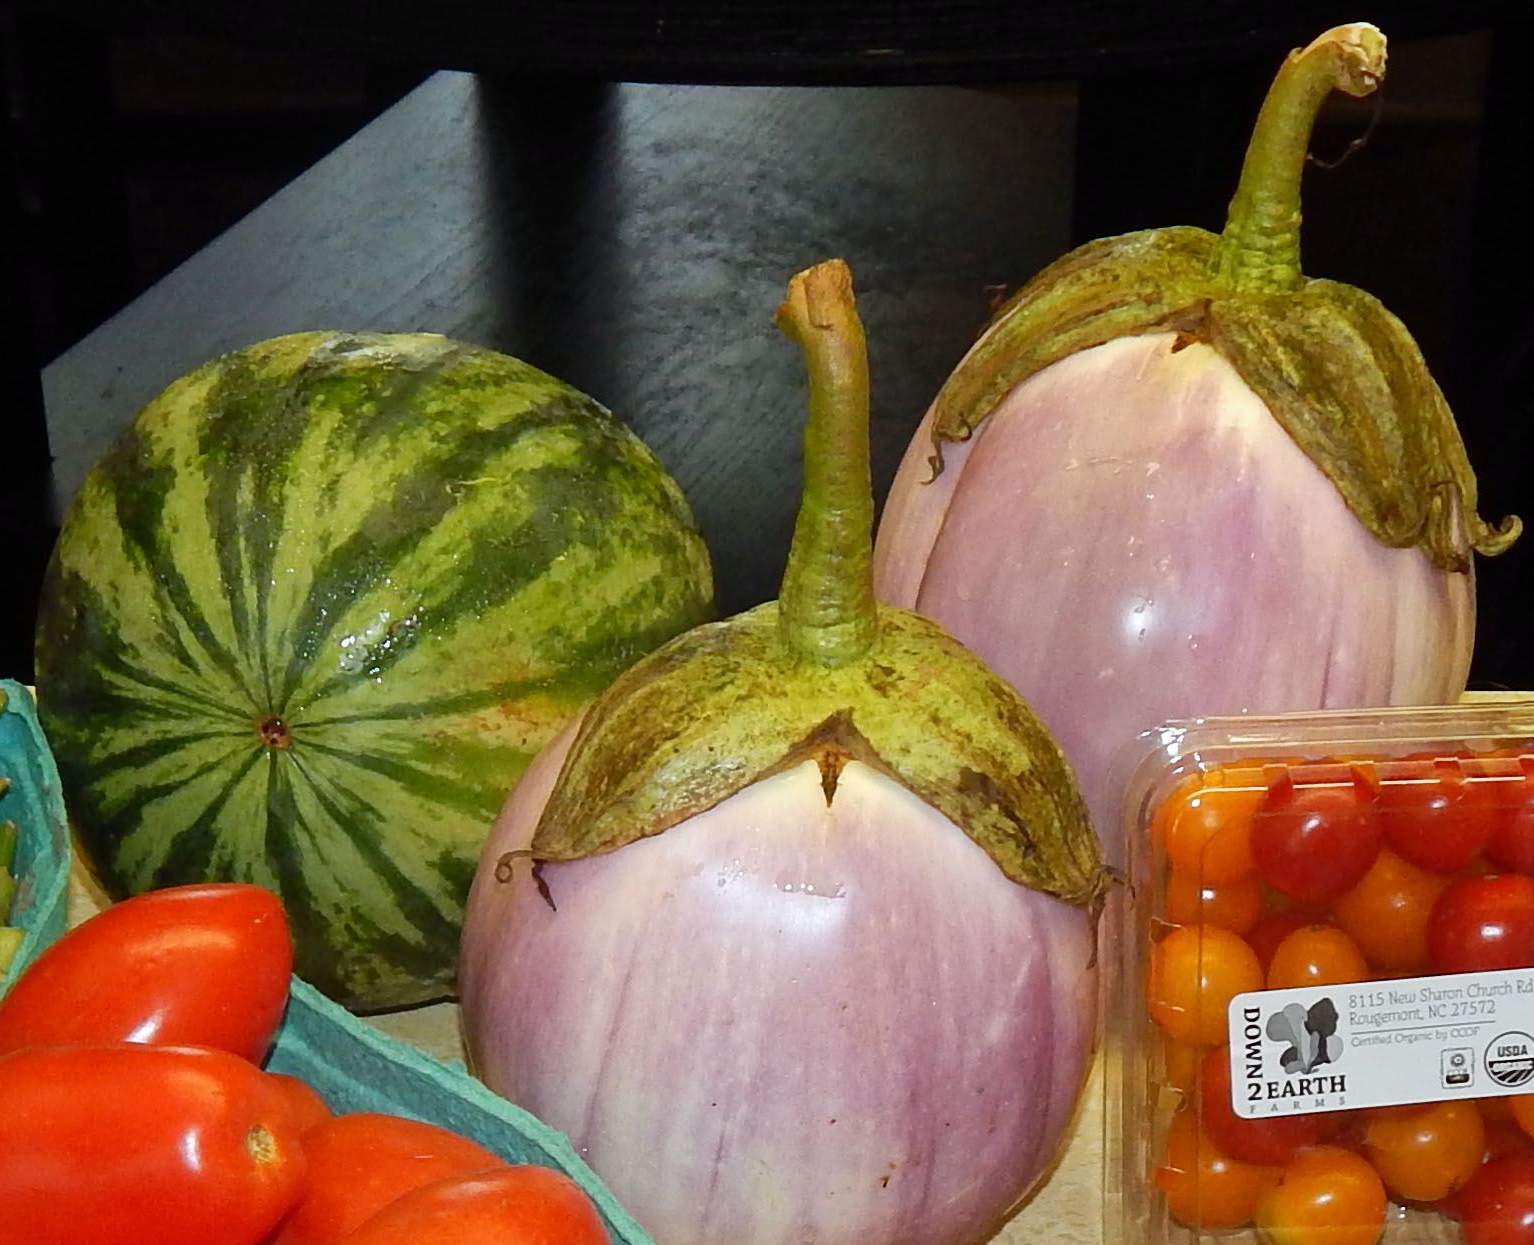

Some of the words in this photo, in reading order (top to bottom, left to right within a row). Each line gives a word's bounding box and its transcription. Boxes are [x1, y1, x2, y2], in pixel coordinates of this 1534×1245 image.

[1349, 992, 1385, 1008] 8115
[1388, 991, 1416, 1005] New
[1420, 987, 1463, 1003] Sharon
[1467, 981, 1513, 998] Church
[1517, 978, 1534, 994] Rd
[1428, 1004, 1447, 1019] NC
[1451, 999, 1497, 1017] 27572
[1244, 1006, 1263, 1079] DOWN
[1351, 1033, 1392, 1047] Certified
[1394, 1030, 1433, 1045] Organic
[1435, 1029, 1448, 1041] by
[1497, 1044, 1528, 1058] USDA
[1247, 1082, 1263, 1101] 2
[1267, 1074, 1347, 1100] EARTH
